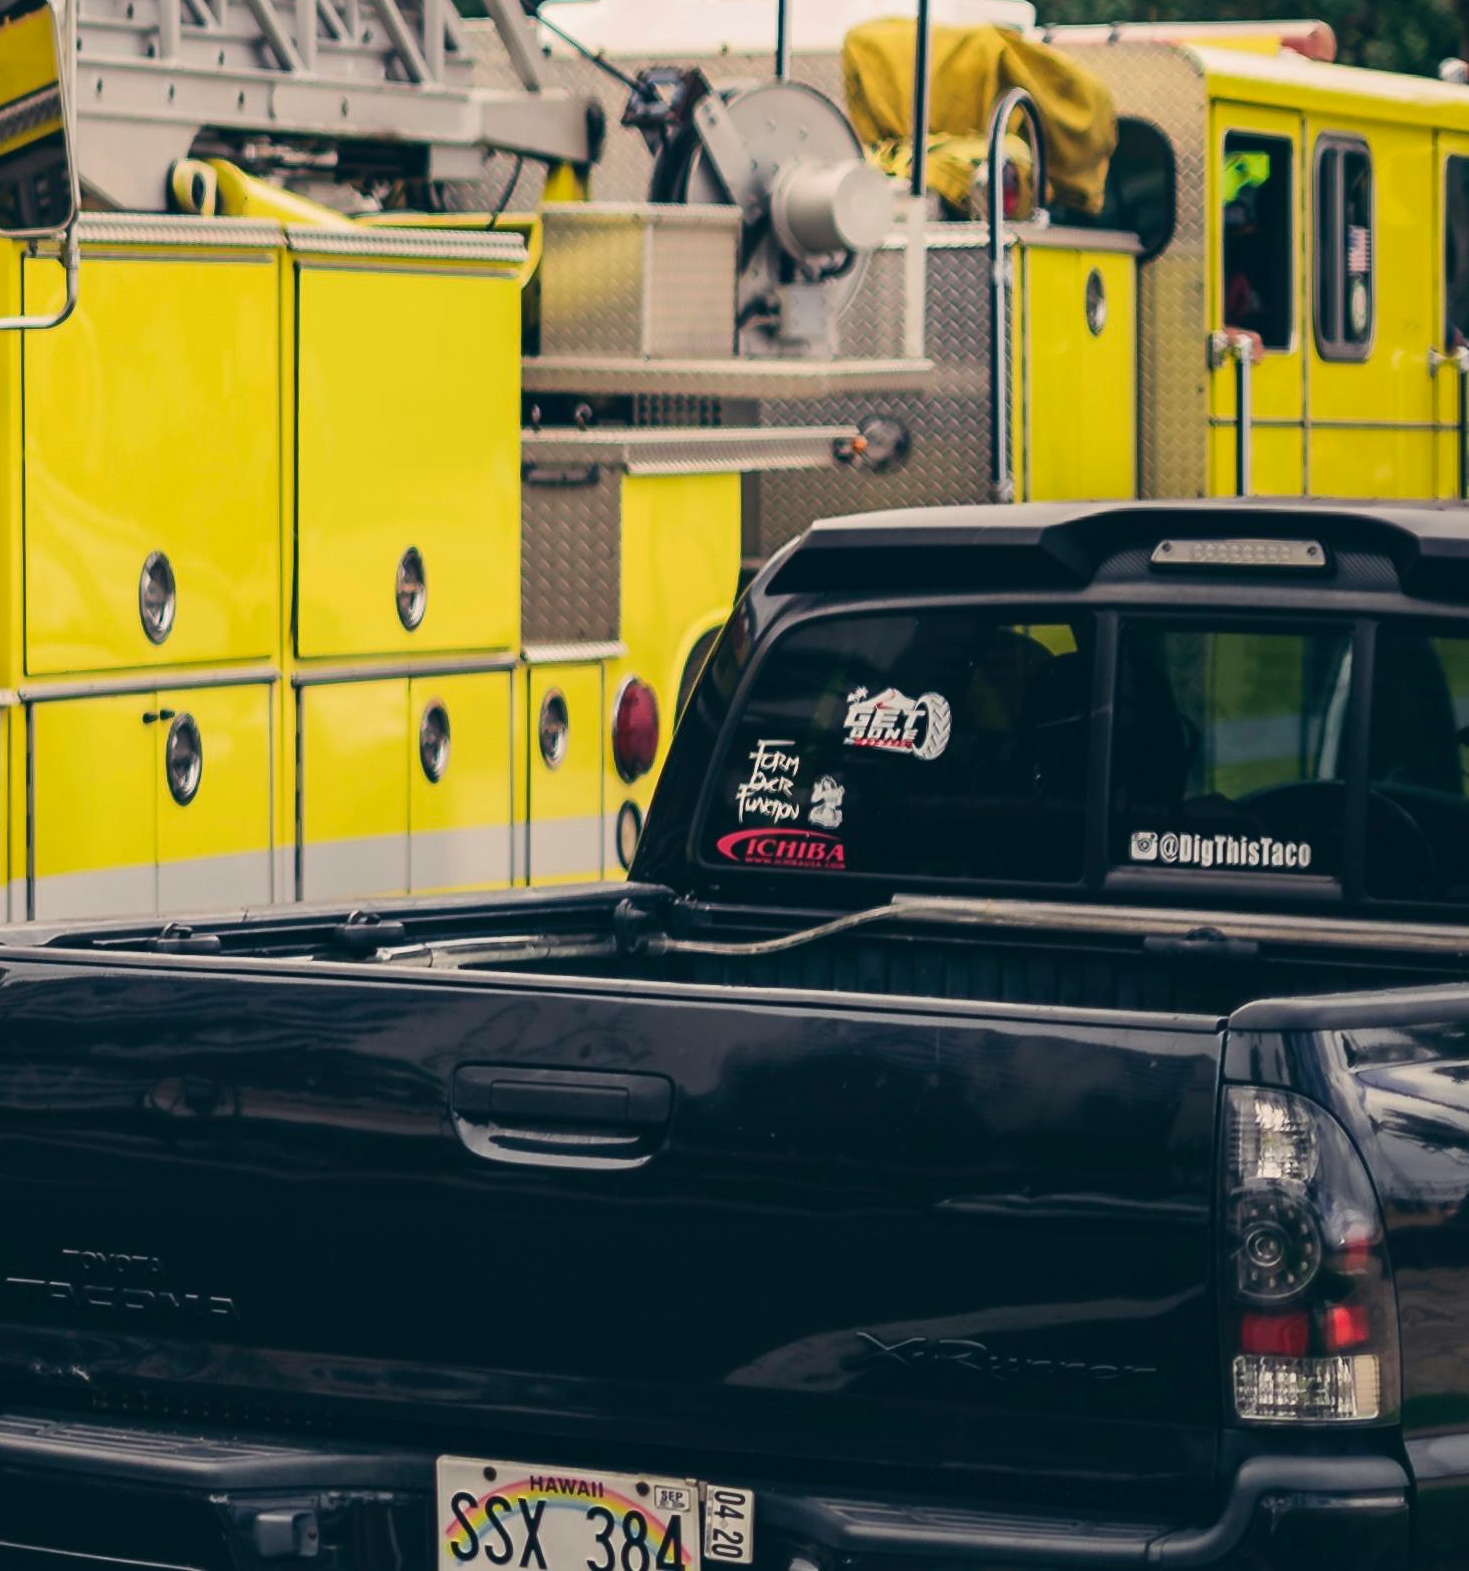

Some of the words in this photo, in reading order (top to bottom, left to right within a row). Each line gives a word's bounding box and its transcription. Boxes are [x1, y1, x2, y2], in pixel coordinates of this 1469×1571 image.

[843, 706, 926, 730] GET
[745, 838, 845, 862] ICHIBA
[1159, 832, 1312, 869] @DigThisTaco
[530, 1475, 605, 1498] HAWAII
[660, 1489, 683, 1502] SEP
[713, 1490, 746, 1520] 04
[450, 1492, 548, 1571] SSX
[586, 1506, 684, 1571] 384
[711, 1531, 744, 1560] 20
